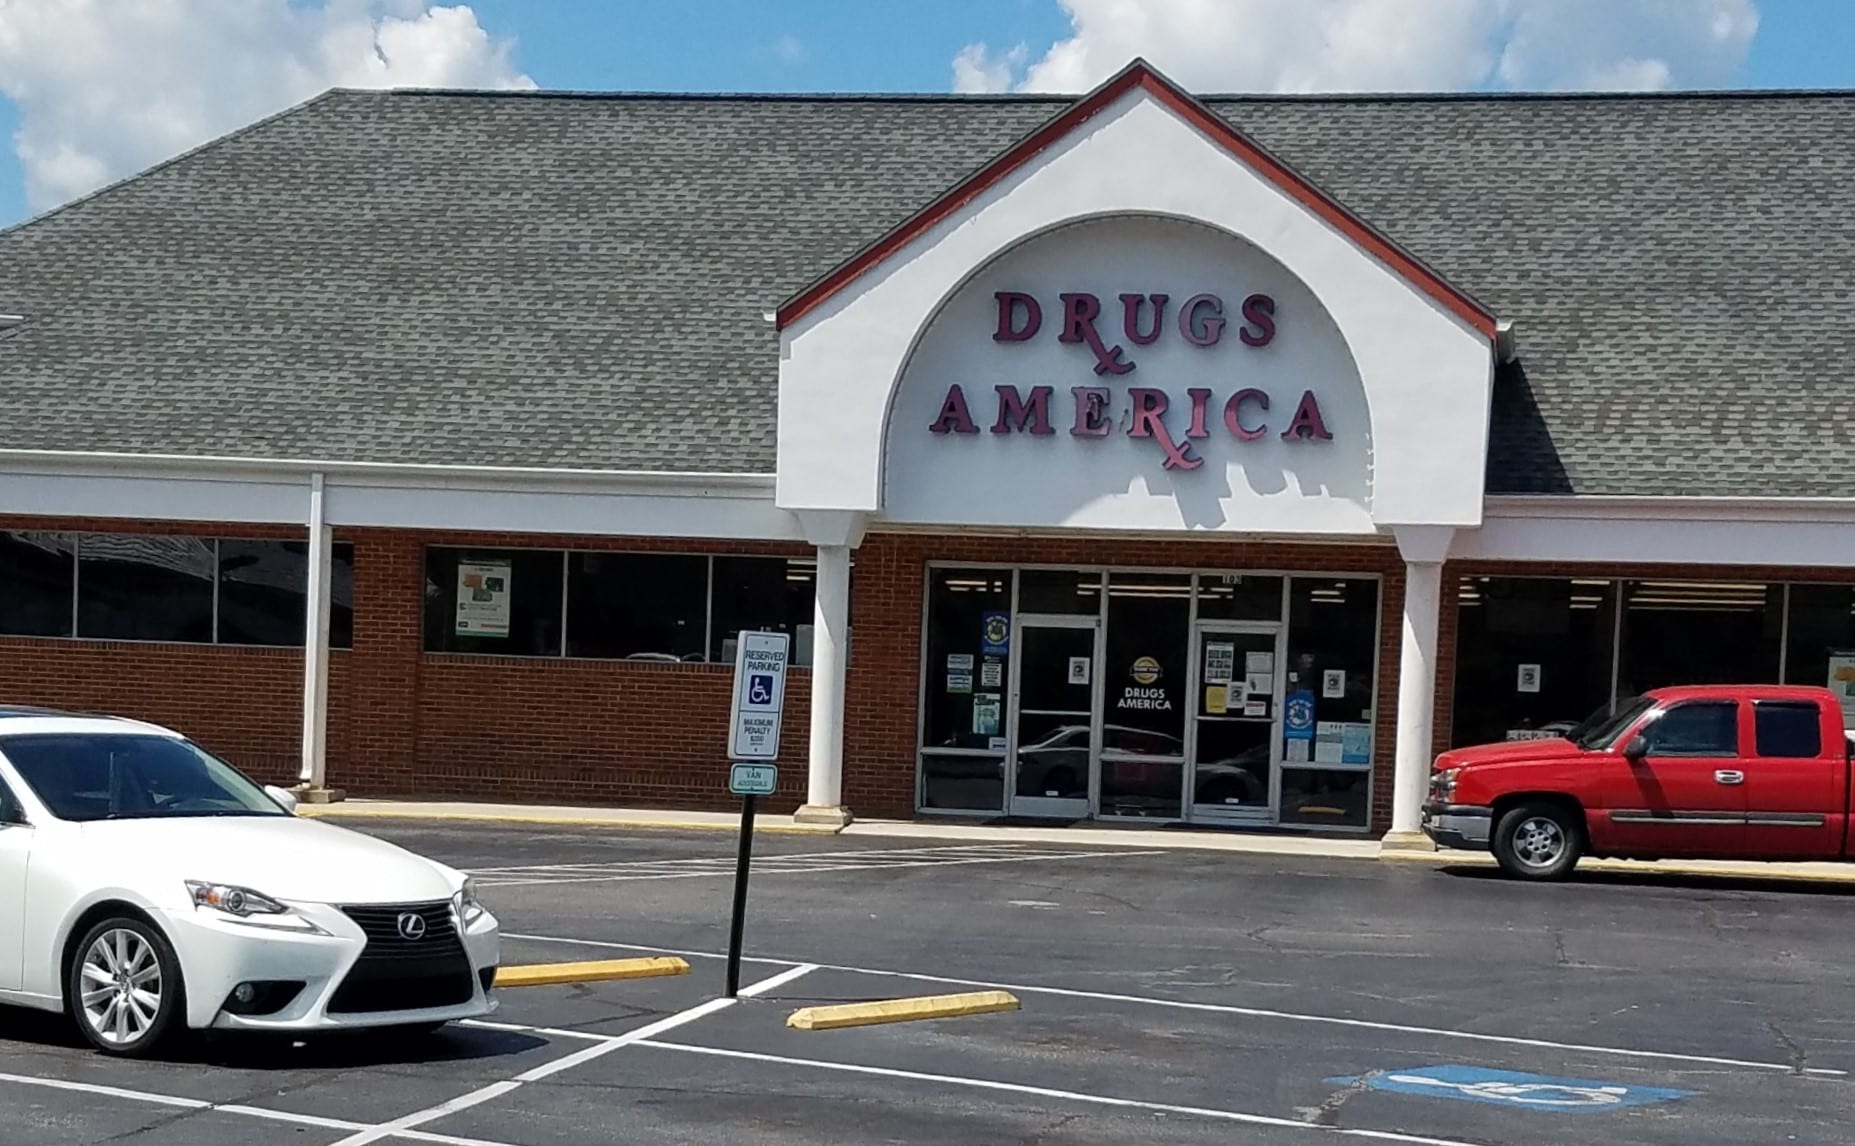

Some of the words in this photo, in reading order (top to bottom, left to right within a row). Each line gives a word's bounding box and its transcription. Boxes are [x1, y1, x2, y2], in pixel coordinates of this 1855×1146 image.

[993, 291, 1276, 375] DRUGS
[928, 384, 1334, 470] AMERICA
[745, 650, 784, 661] RESERVED
[747, 661, 781, 672] PARKING
[1125, 687, 1165, 699] DRUGS
[1117, 698, 1172, 710] AMERICA
[743, 718, 774, 727] MAXIMUM
[744, 726, 771, 735] PENALTY
[746, 770, 761, 779] VAN
